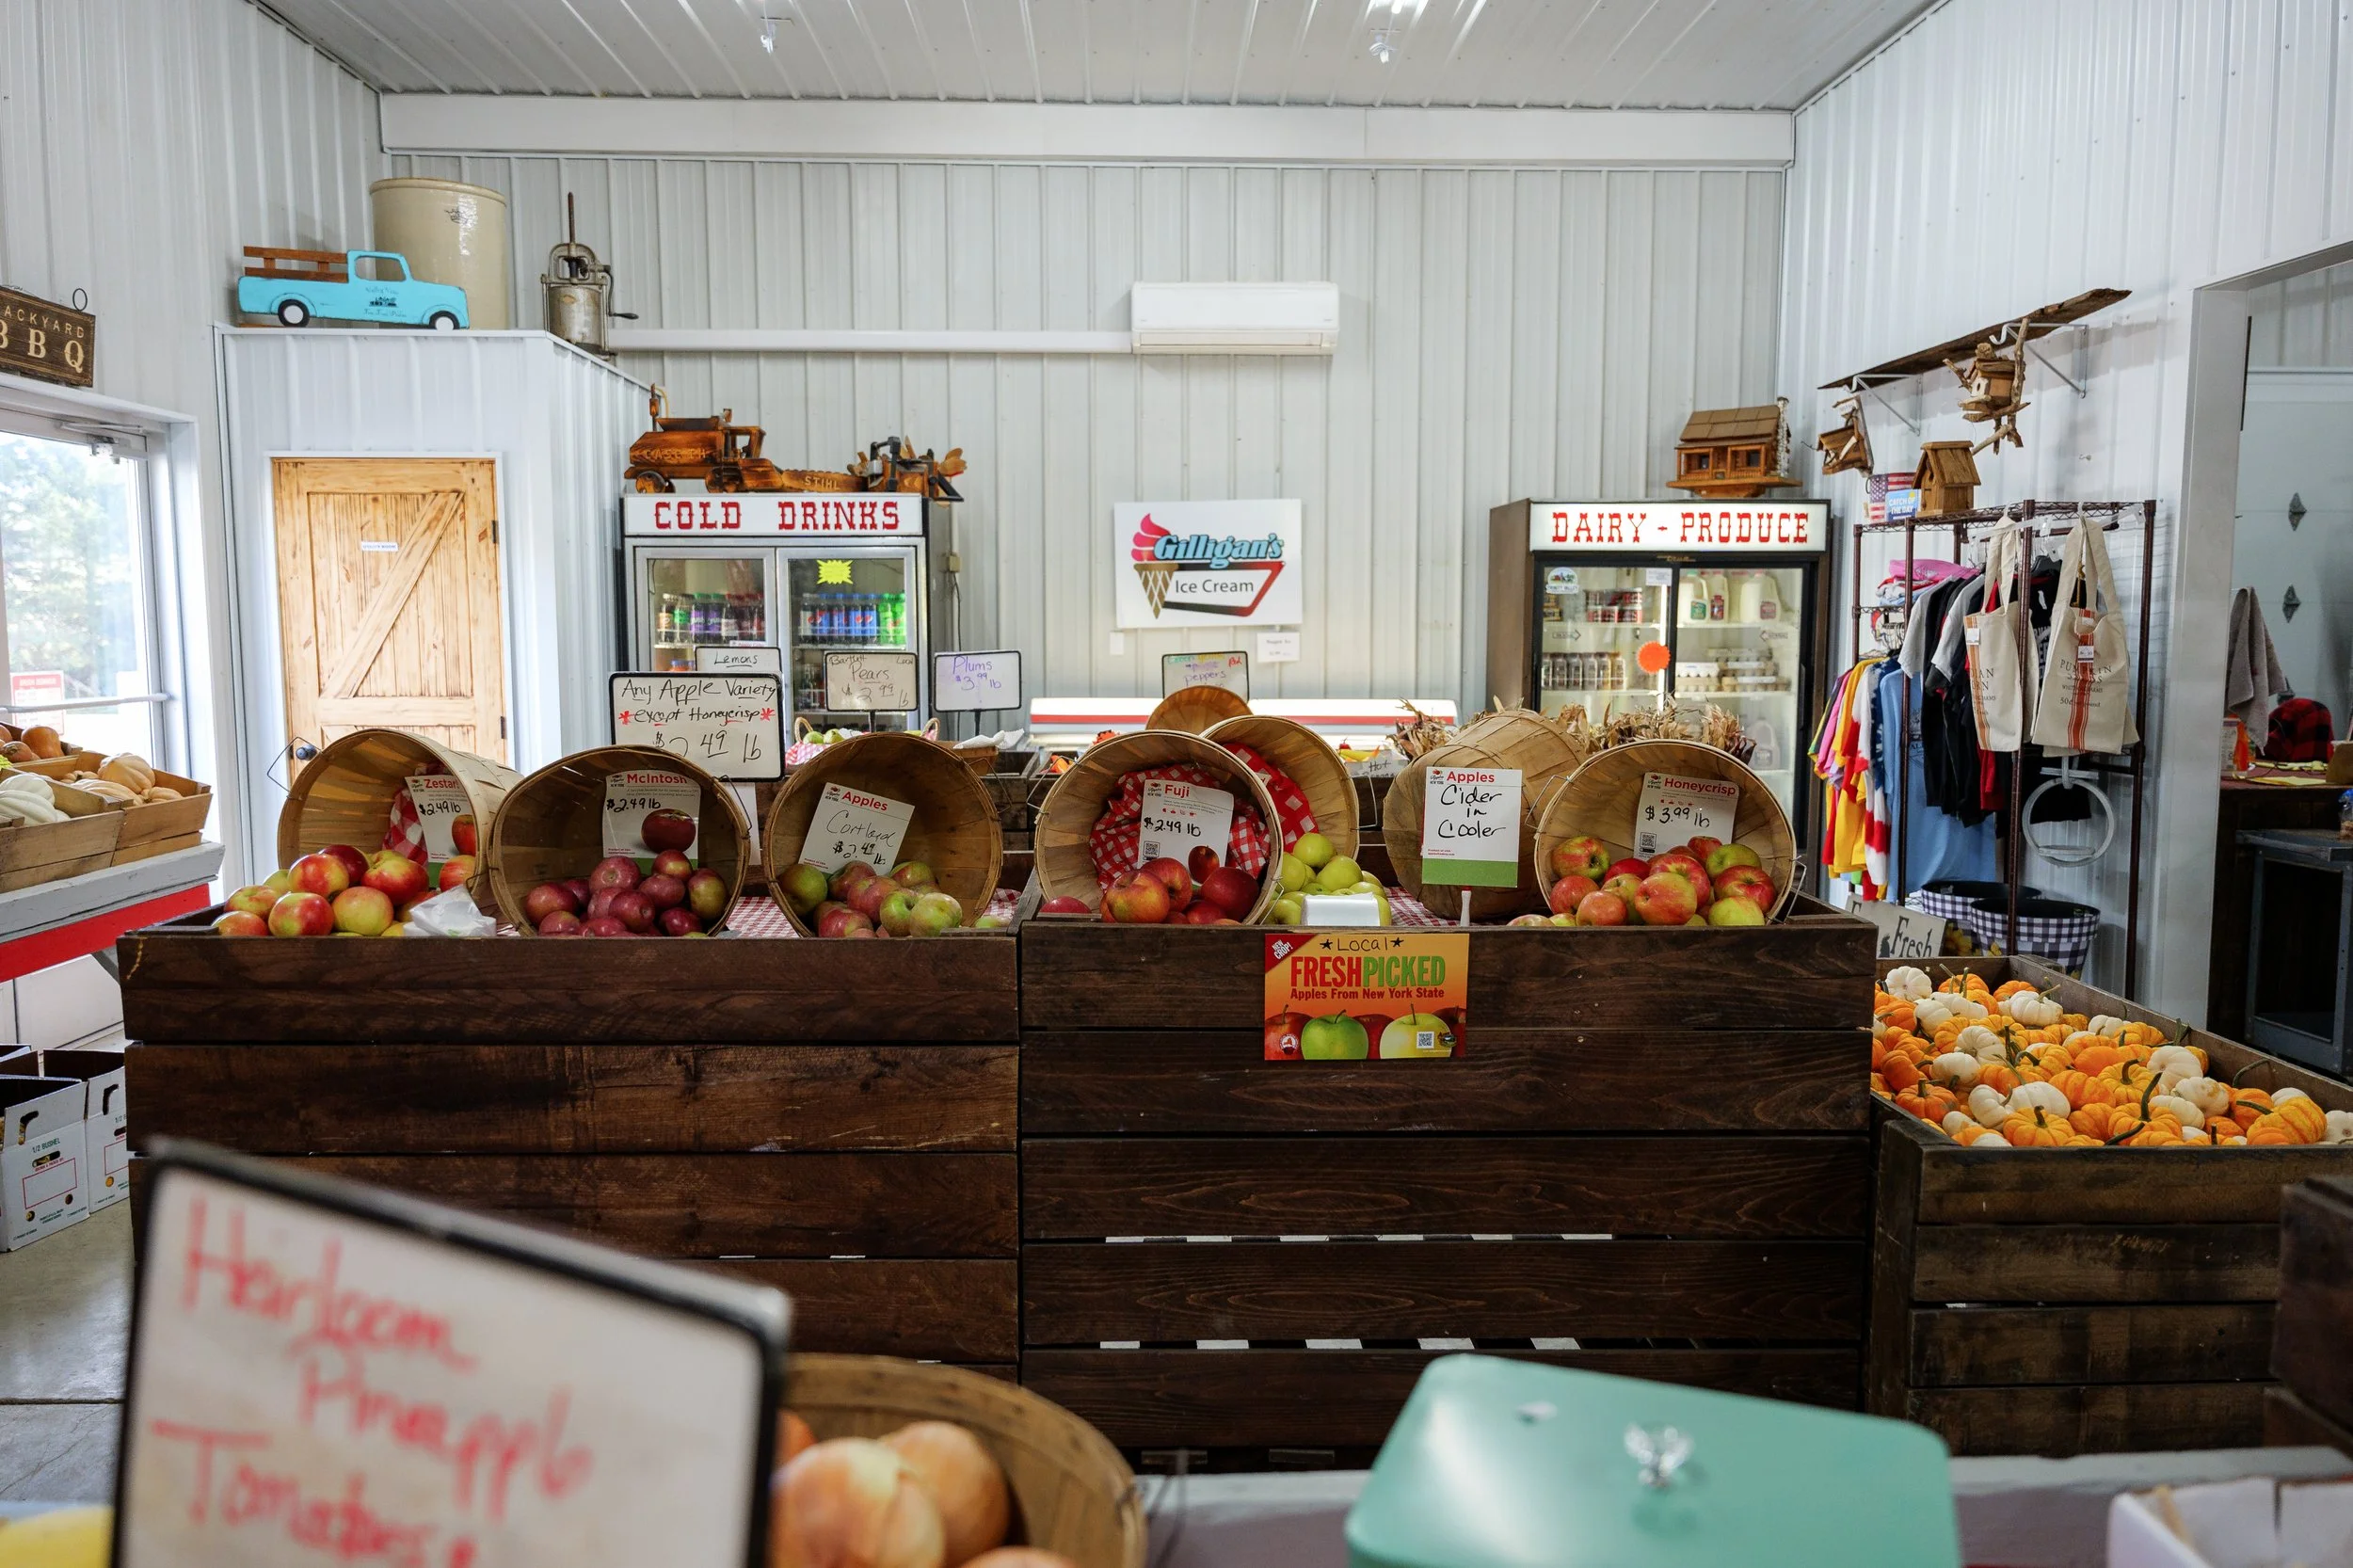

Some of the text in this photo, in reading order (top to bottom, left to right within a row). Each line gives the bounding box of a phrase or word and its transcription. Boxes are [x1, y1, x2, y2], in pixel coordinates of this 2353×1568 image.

[4, 305, 85, 339] ACKYARD
[805, 475, 840, 490] STIHL
[654, 501, 900, 531] COLD DRINKS
[1552, 512, 1646, 543] DAIRY
[1680, 512, 1809, 543] PRODUCE
[1153, 533, 1285, 569] Gilligan's
[1176, 579, 1254, 594] Ice Cream
[714, 652, 758, 664] Lemons
[952, 654, 993, 675] Plums
[850, 662, 889, 681] Pears
[1185, 671, 1226, 686] peppers
[621, 679, 776, 706] Any Apple Variety
[990, 680, 1002, 689] lb
[899, 690, 909, 709] lb
[633, 706, 760, 727] except Honeycrisp
[743, 733, 761, 763] lb
[1369, 760, 1392, 772] Hot
[626, 774, 688, 784] McIntosh
[1447, 771, 1496, 783] Apples
[1164, 784, 1191, 798] Fuji
[1440, 784, 1503, 806] Cider
[1664, 777, 1737, 797] Honeycrisp
[451, 802, 462, 813] lb
[606, 798, 662, 813] $2.49 lb
[842, 792, 888, 811] Apples
[1466, 804, 1487, 818] in
[1144, 817, 1201, 837] $2.49 lb
[1694, 812, 1710, 828] lb
[1437, 819, 1507, 839] Cooler
[1273, 939, 1284, 951] NEW
[1337, 936, 1388, 952] Local
[1891, 915, 1933, 958] Fresh
[1273, 941, 1294, 960] CROP!
[1290, 987, 1445, 1000] Apples From New York State
[41, 1138, 61, 1151] BUSHEL
